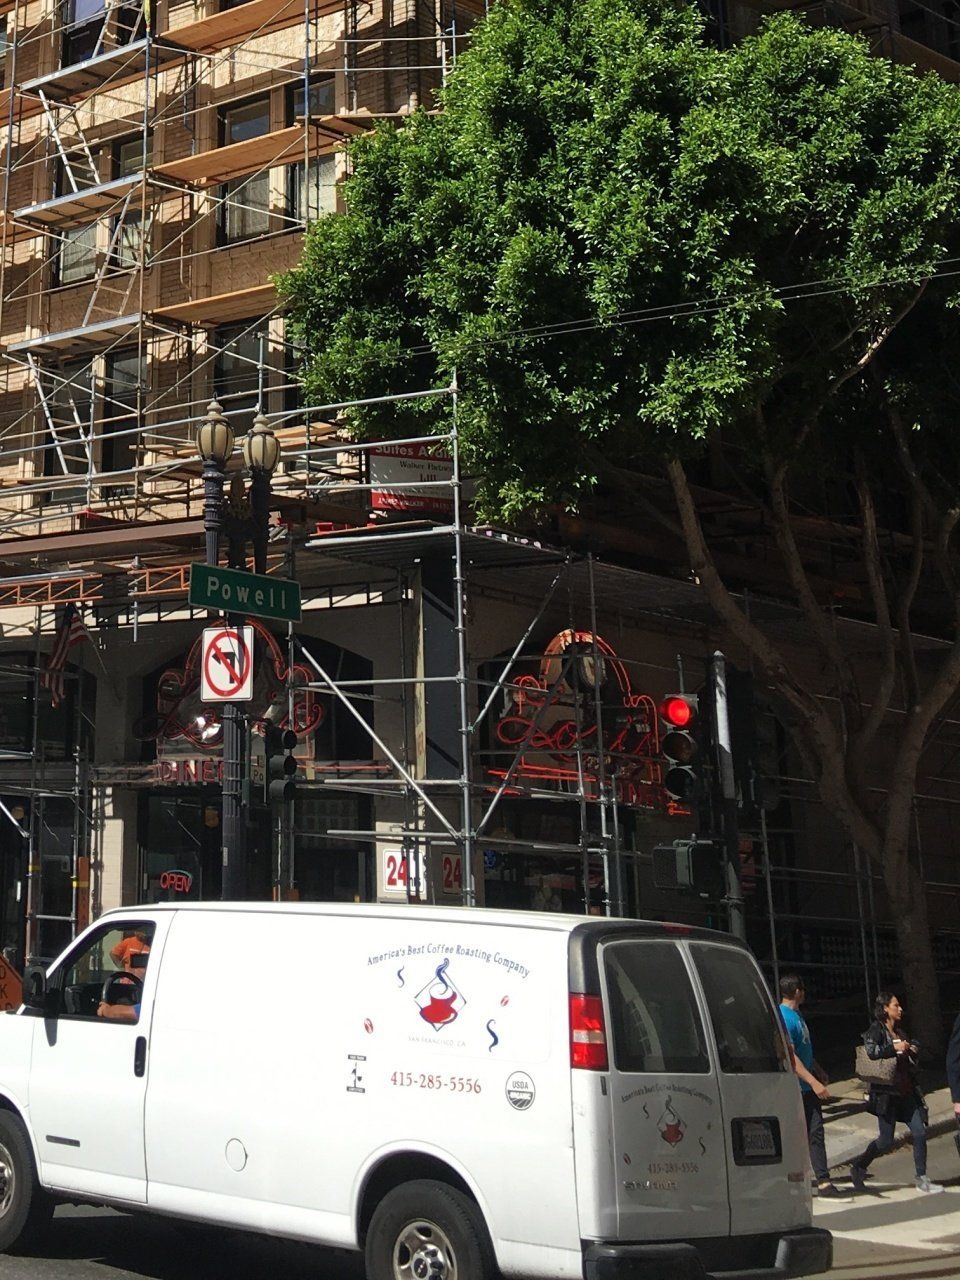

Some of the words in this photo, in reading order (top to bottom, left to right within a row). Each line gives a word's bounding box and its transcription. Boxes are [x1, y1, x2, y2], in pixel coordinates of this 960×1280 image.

[207, 576, 286, 610] Powell
[159, 872, 193, 894] OPEN
[386, 854, 408, 887] 24
[367, 948, 406, 966] America's
[407, 945, 425, 956] Best
[426, 943, 454, 954] Coffee
[455, 944, 492, 963] Roasting
[493, 951, 530, 979] Company
[390, 1070, 482, 1094] 415-285-5556
[512, 1080, 529, 1089] USDA
